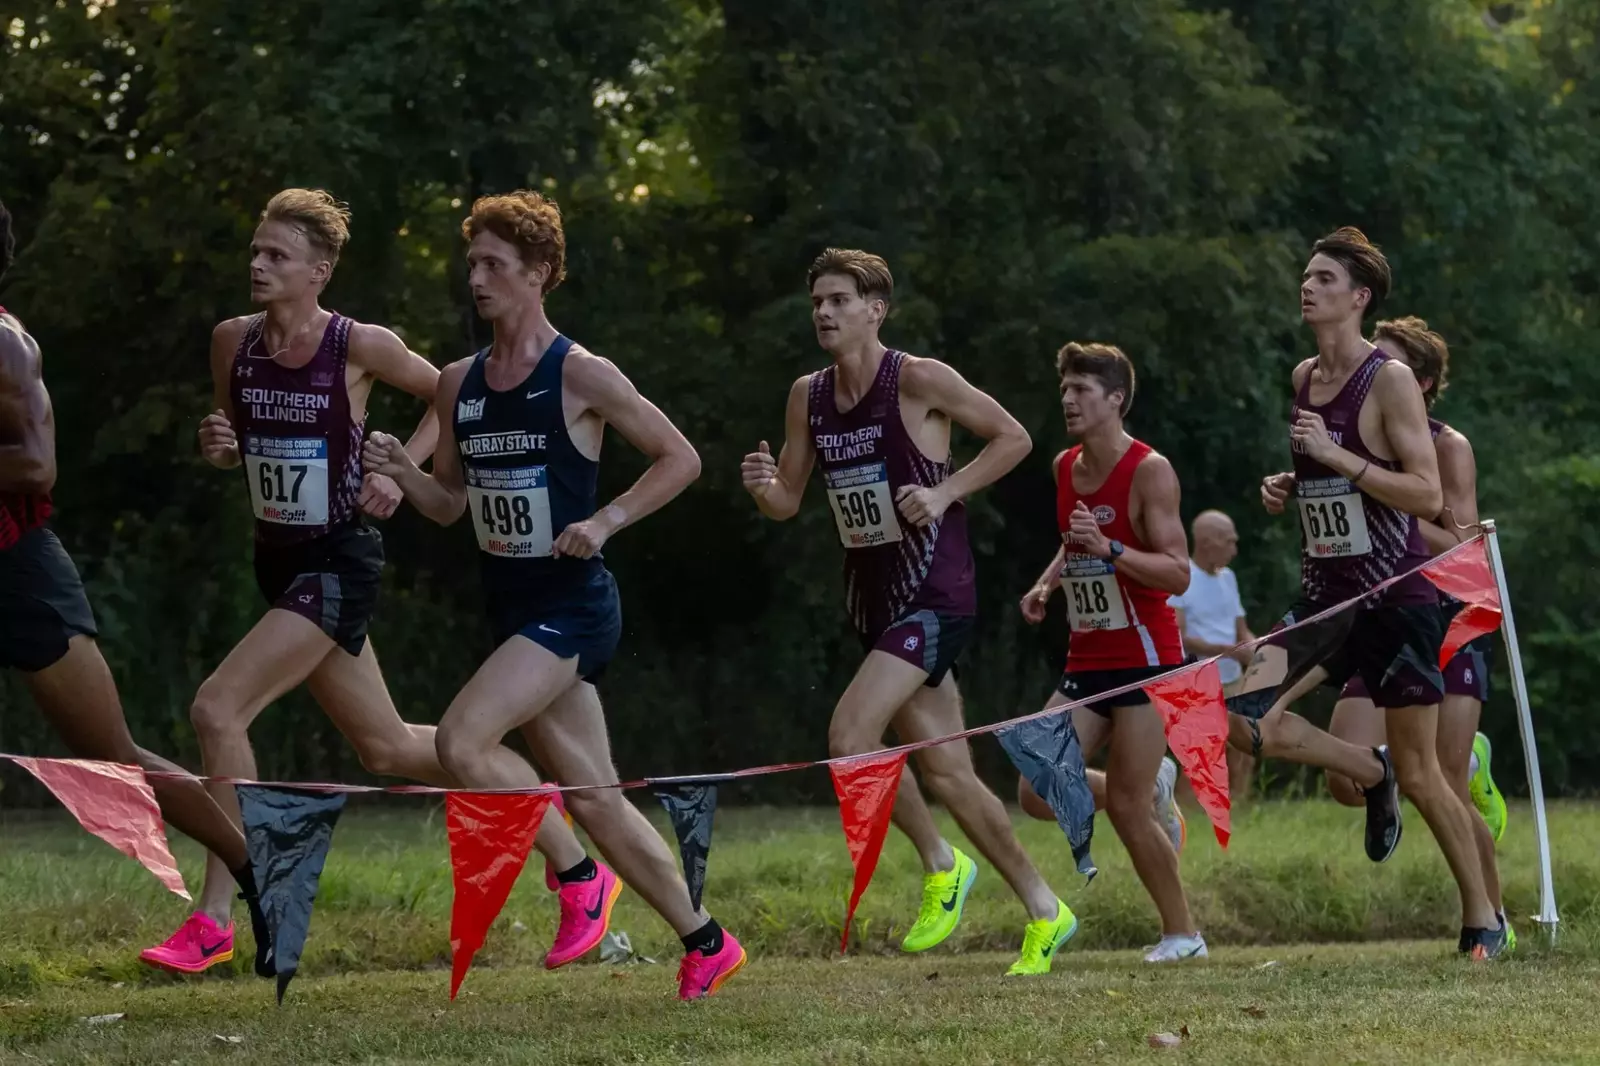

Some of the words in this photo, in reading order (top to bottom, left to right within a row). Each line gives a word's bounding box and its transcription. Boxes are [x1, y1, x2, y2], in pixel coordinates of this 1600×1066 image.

[242, 388, 330, 409] SOUTHERN
[252, 404, 317, 423] ILLINOIS
[275, 440, 293, 448] CROSS
[294, 440, 323, 448] COUNTRY
[506, 434, 546, 451] STATE
[816, 425, 883, 448] SOUTHERN
[262, 447, 317, 458] CHAMPIONSHIPS
[824, 440, 875, 462] ILLINOIS
[259, 462, 308, 503] 617
[480, 477, 536, 488] CHAMPIONSHIPS
[511, 468, 541, 479] COUNTRY
[263, 506, 307, 523] MileSplit
[482, 495, 534, 536] 498
[836, 489, 881, 529] 596
[1305, 501, 1351, 538] 618
[487, 539, 533, 556] MileSplit
[1071, 580, 1109, 615] 518
